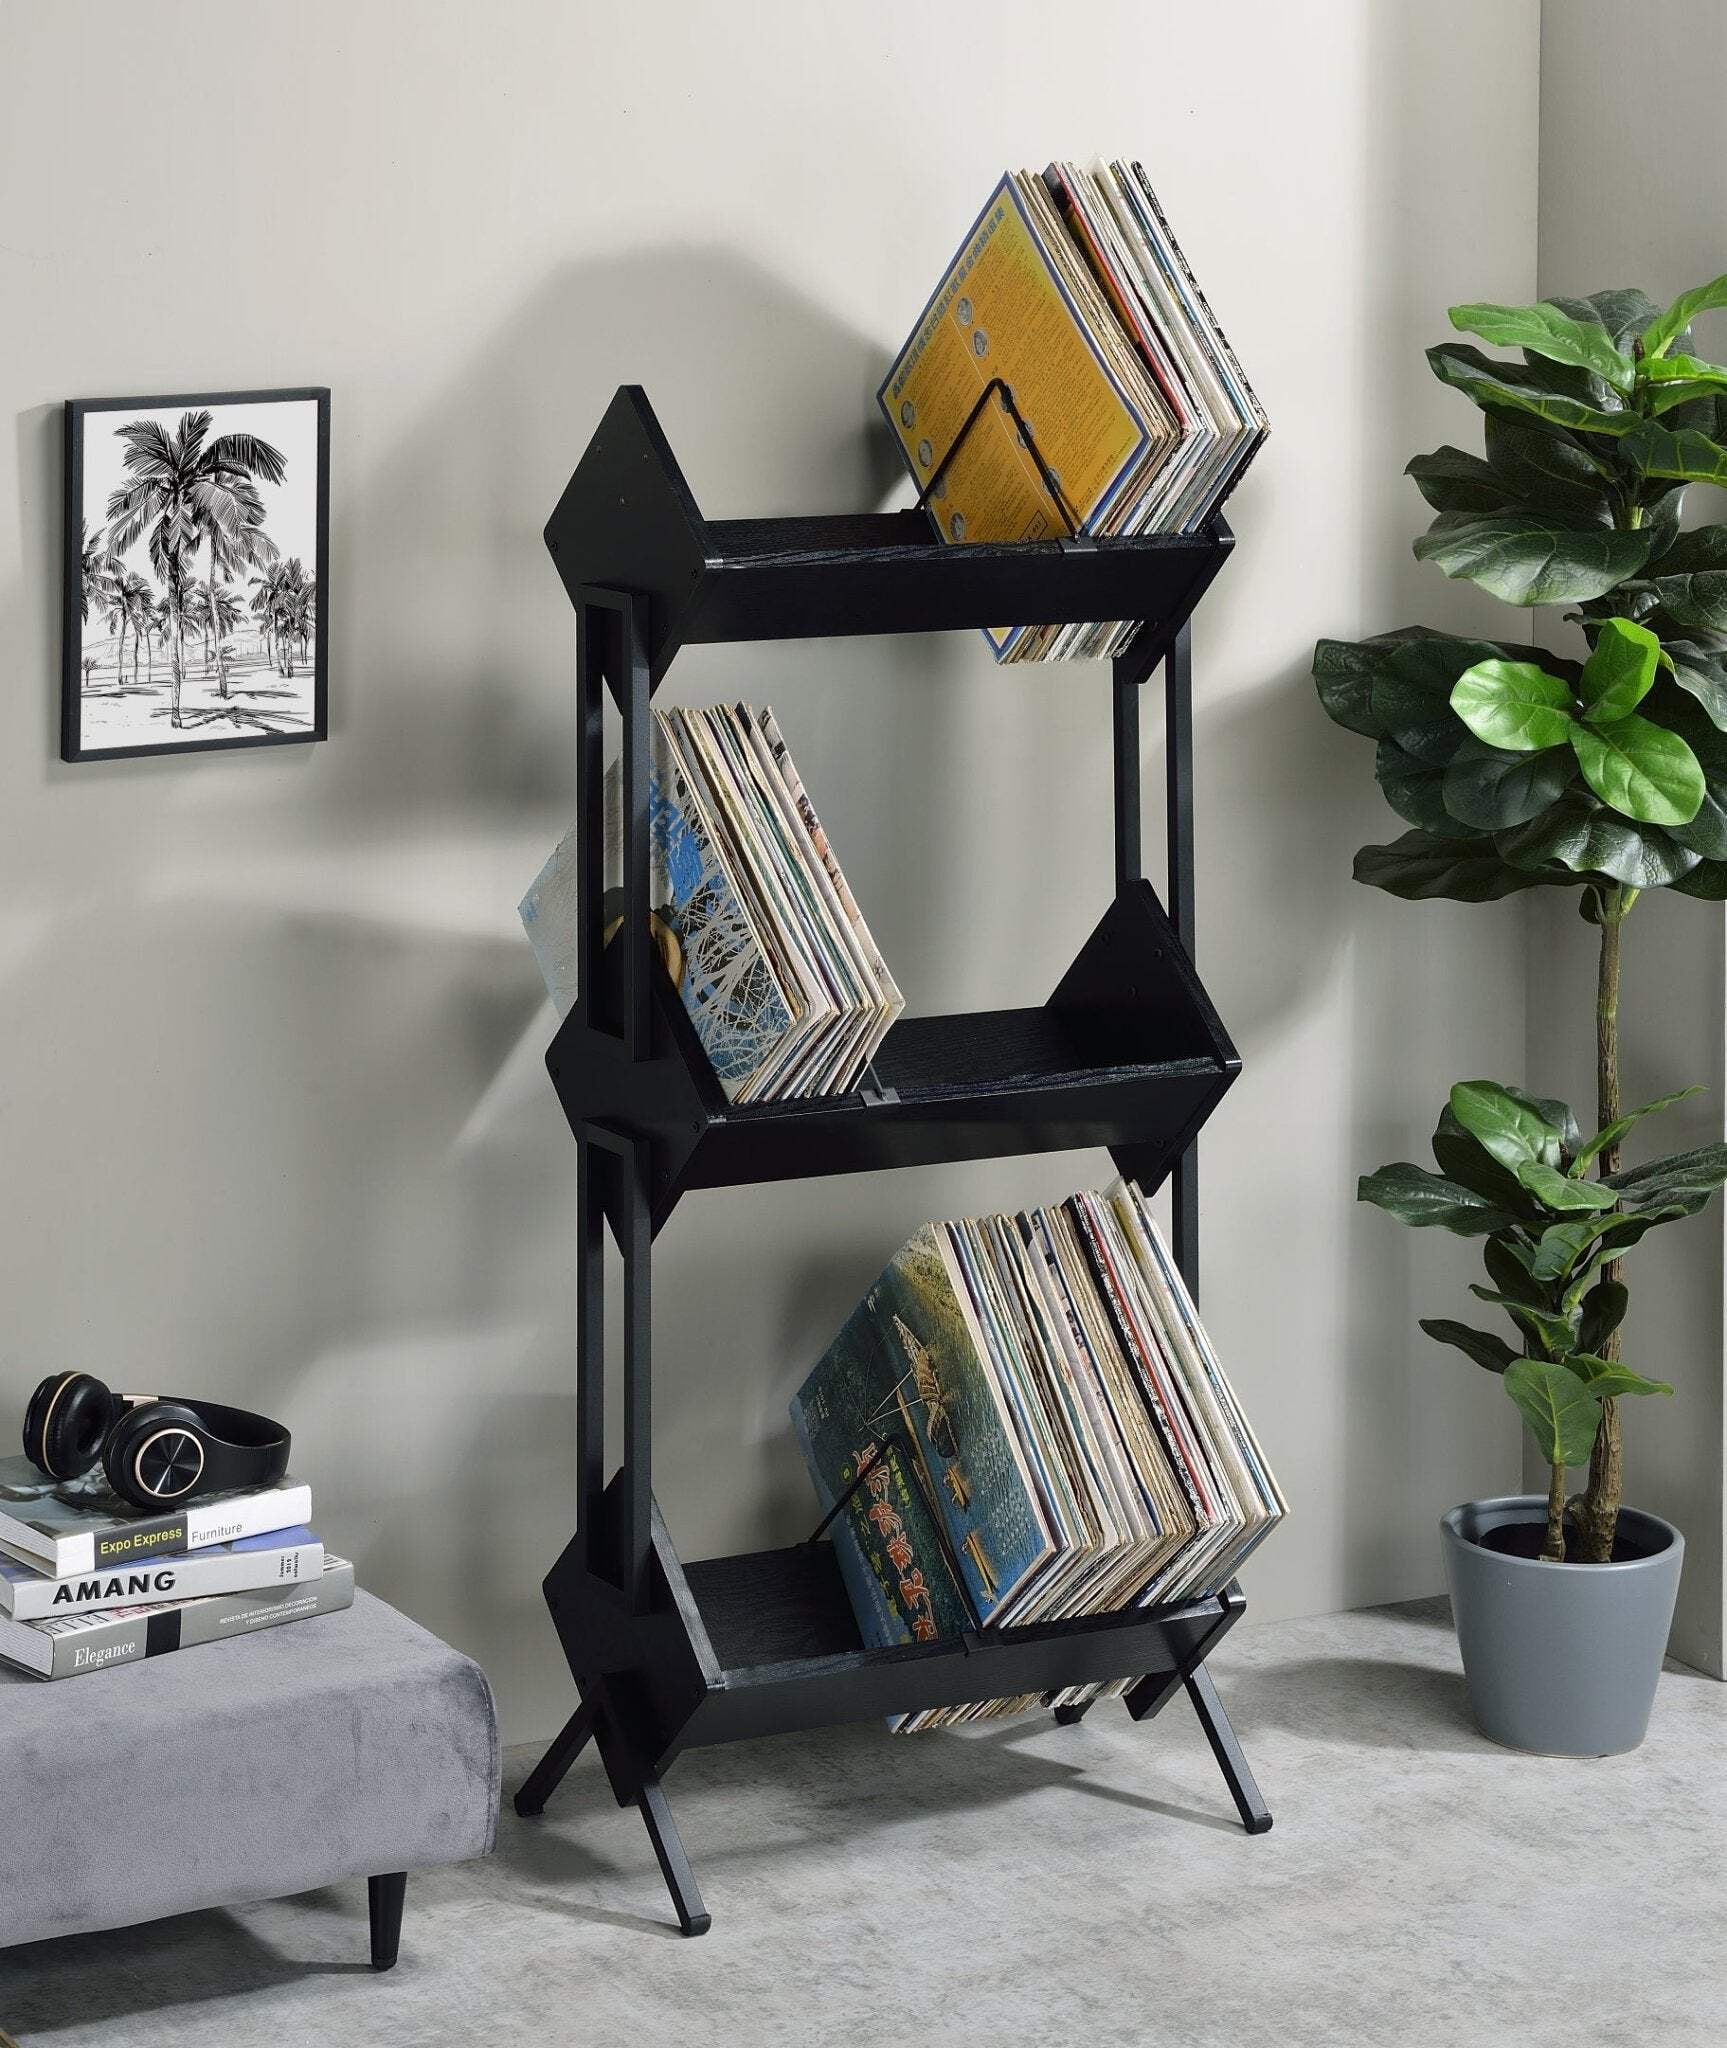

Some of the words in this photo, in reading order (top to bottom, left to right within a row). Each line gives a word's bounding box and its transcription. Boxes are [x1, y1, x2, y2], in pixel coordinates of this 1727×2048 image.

[100, 1539, 131, 1554] Expo
[134, 1528, 182, 1547] Express
[191, 1523, 243, 1543] Furniture
[52, 1570, 177, 1605] AMANG
[73, 1640, 136, 1668] Elegance
